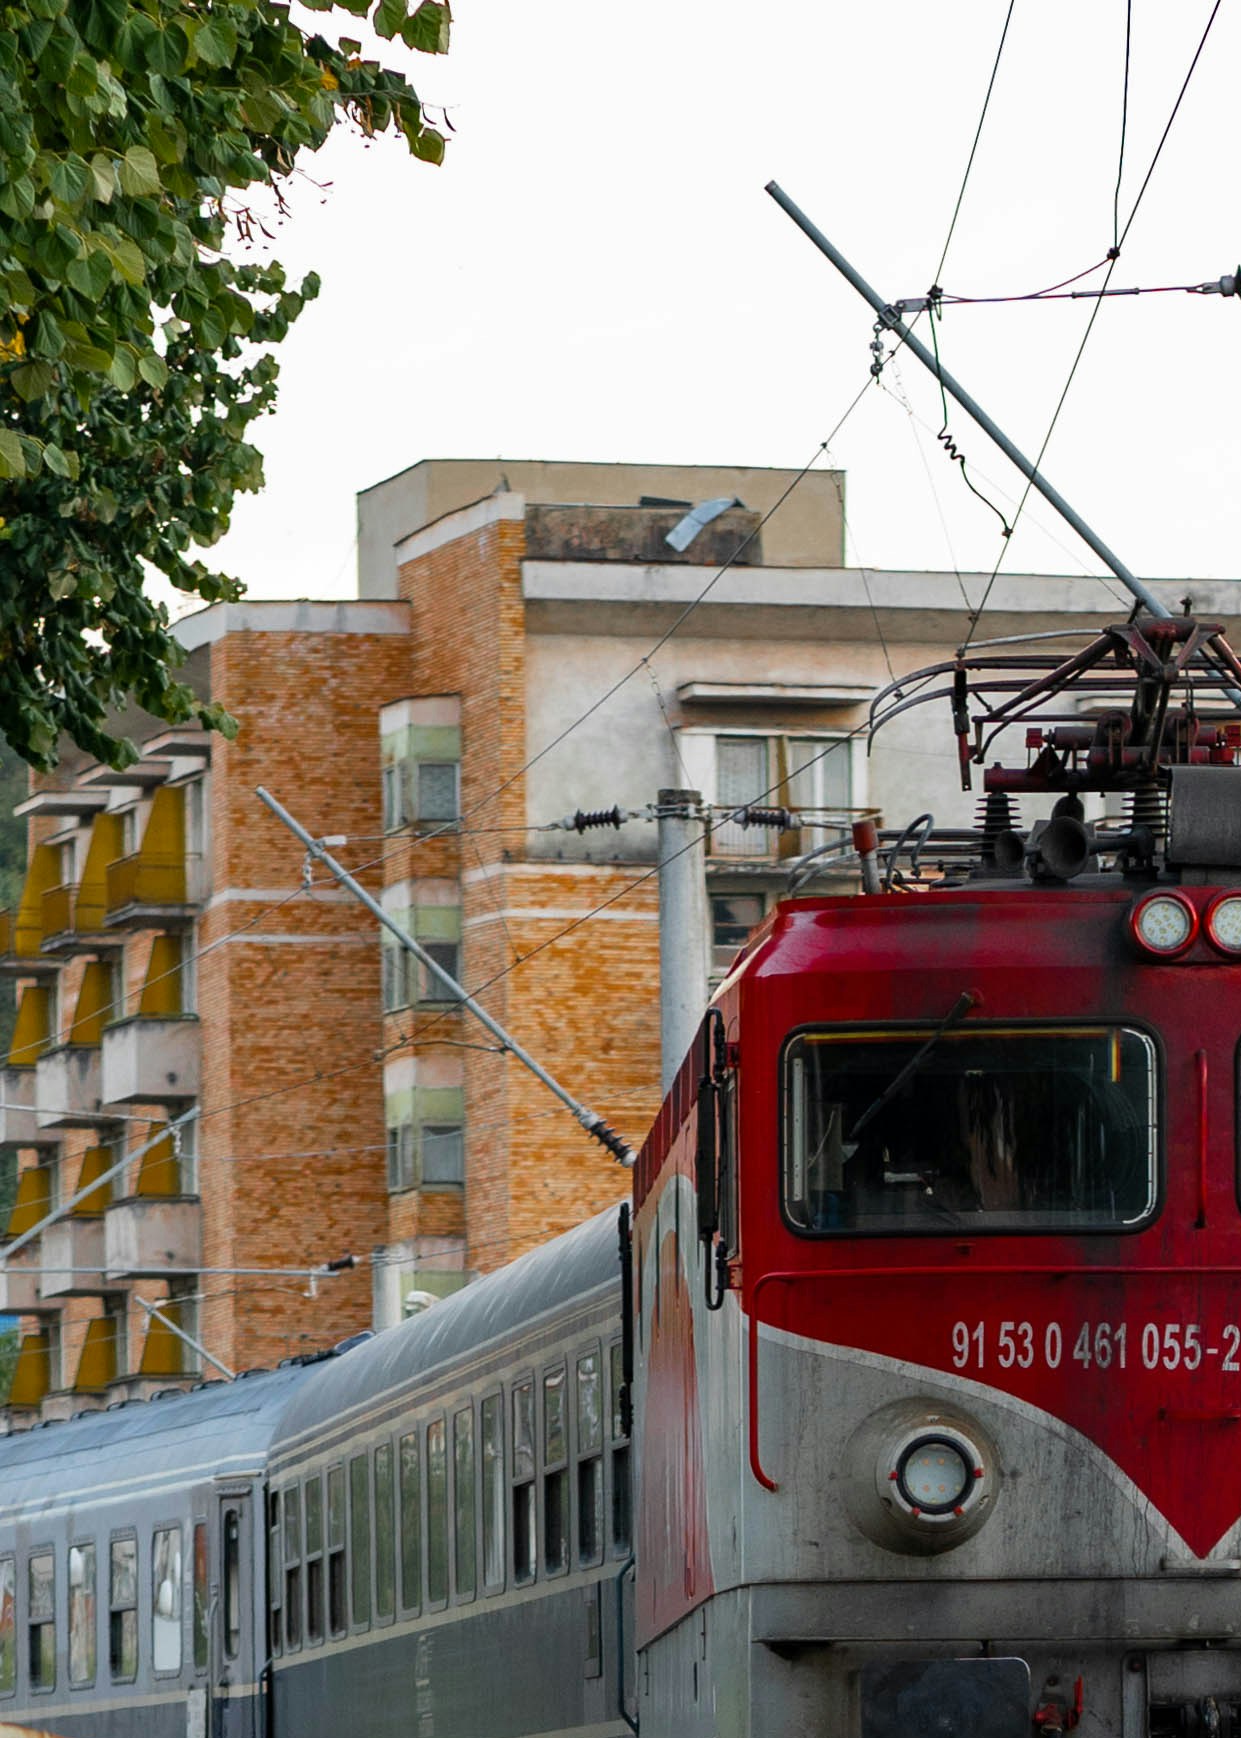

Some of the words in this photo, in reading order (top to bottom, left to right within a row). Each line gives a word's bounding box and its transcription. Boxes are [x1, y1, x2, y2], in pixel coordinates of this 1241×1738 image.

[952, 1321, 985, 1368] 91
[998, 1321, 1034, 1368] 53
[1044, 1322, 1063, 1369] 0
[1072, 1321, 1127, 1369] 461
[1141, 1322, 1240, 1371] 055-2
